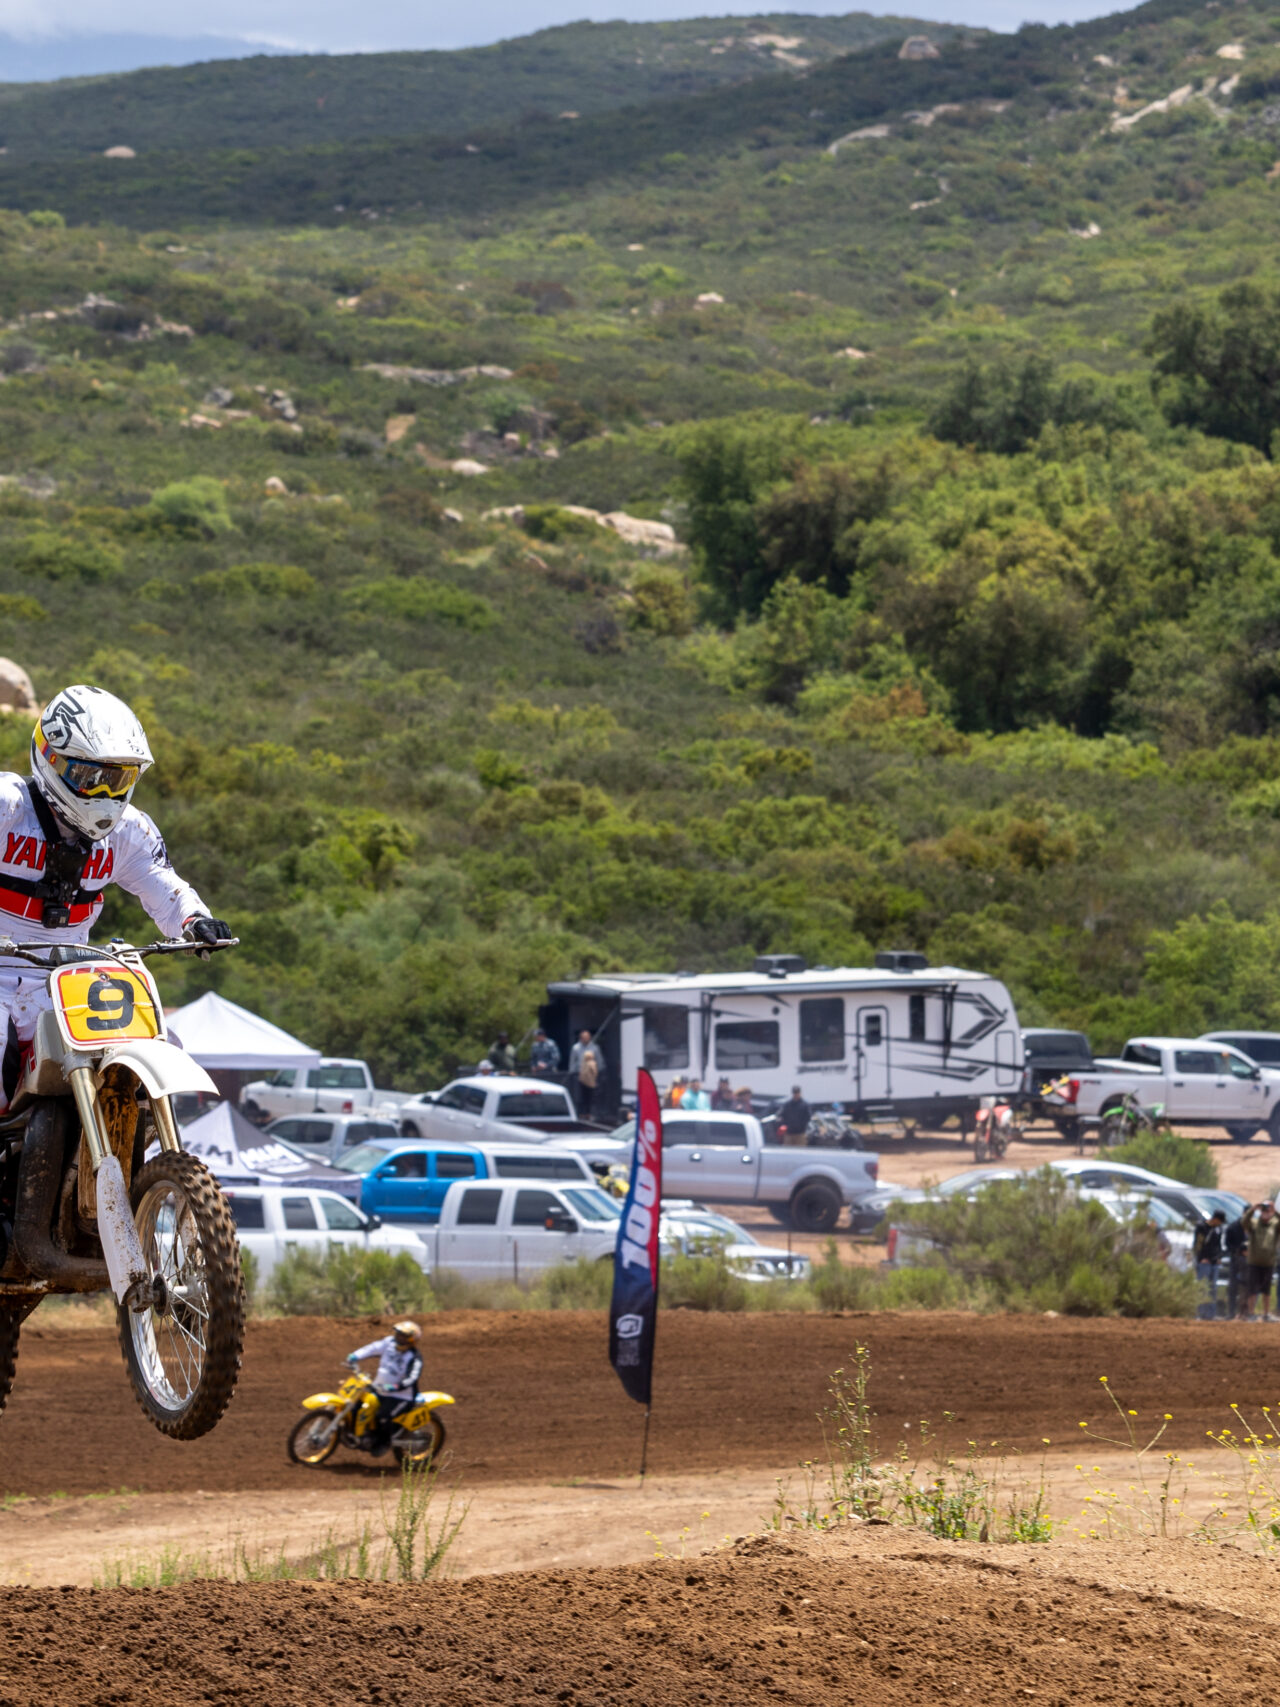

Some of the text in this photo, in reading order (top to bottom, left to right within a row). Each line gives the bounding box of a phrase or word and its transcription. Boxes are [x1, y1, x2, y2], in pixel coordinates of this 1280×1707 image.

[2, 831, 114, 880] YAHA
[86, 978, 134, 1031] 9
[621, 1118, 658, 1270] 100%
